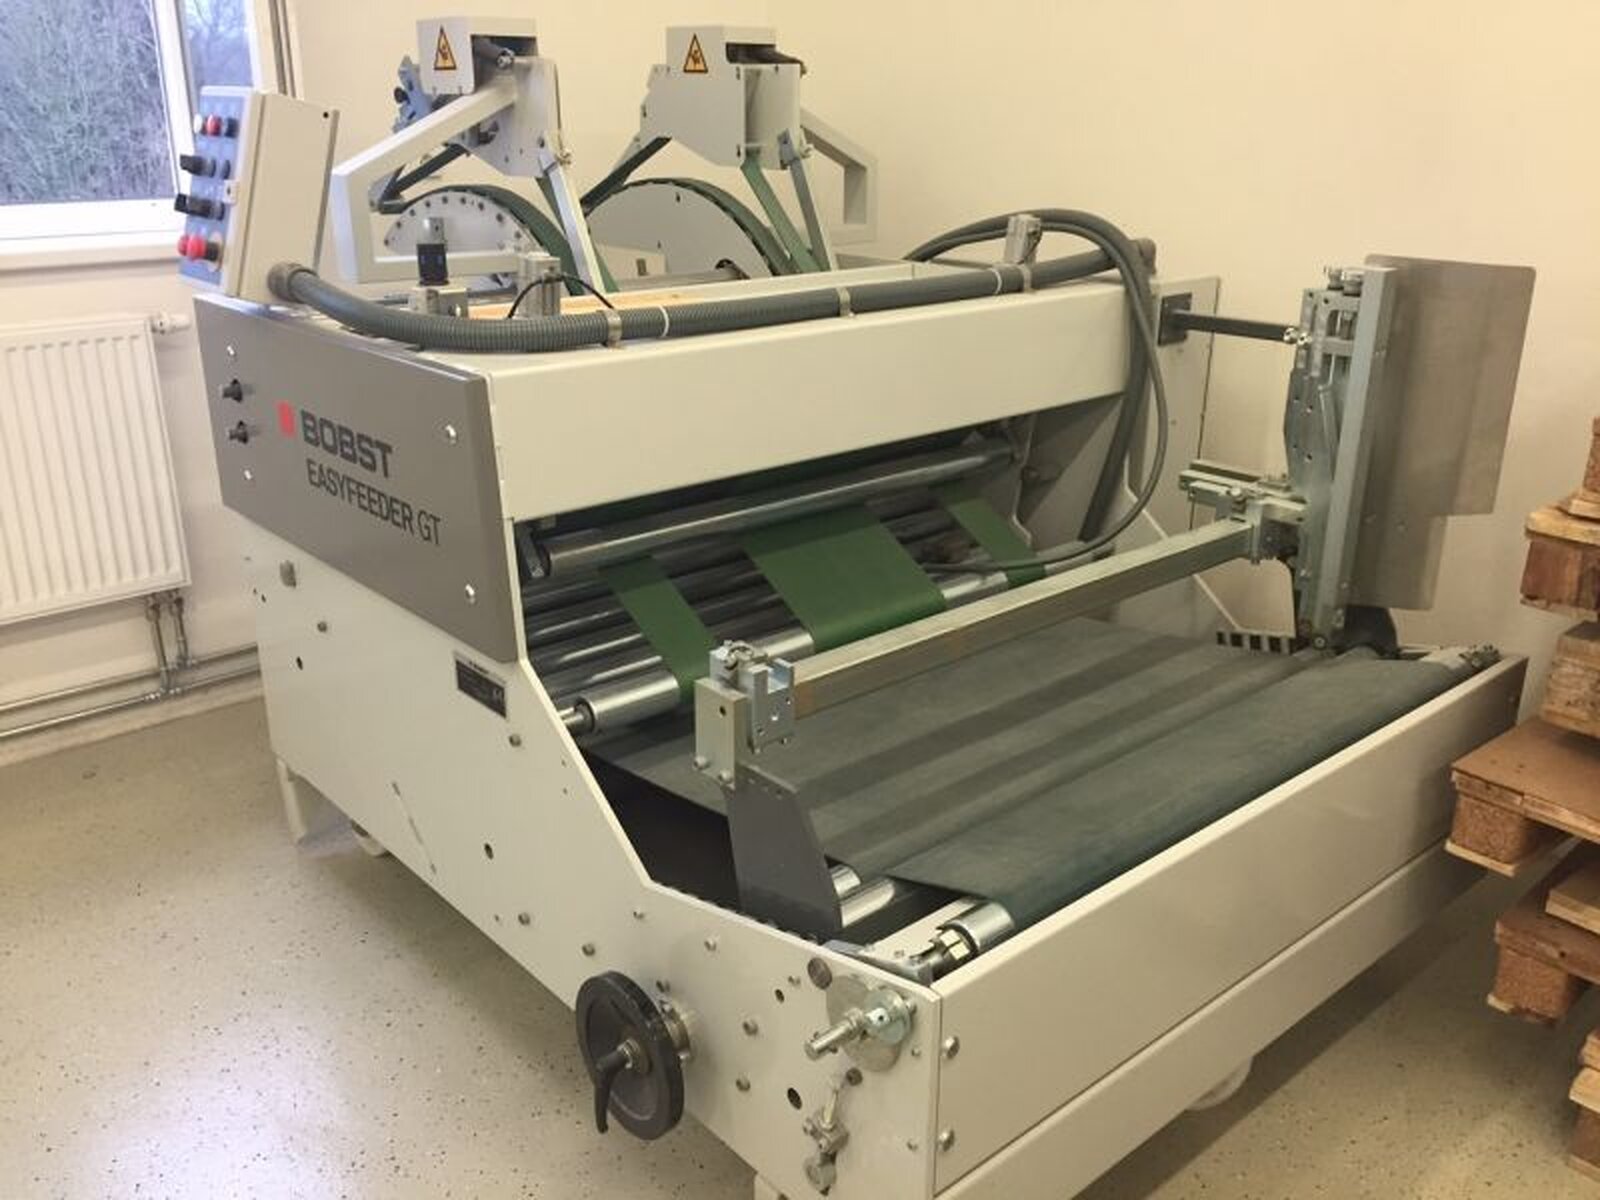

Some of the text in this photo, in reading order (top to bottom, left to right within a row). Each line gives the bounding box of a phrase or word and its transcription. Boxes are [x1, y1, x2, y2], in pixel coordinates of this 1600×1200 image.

[301, 410, 392, 478] BOBST
[306, 458, 441, 546] EASYFEEDER GT
